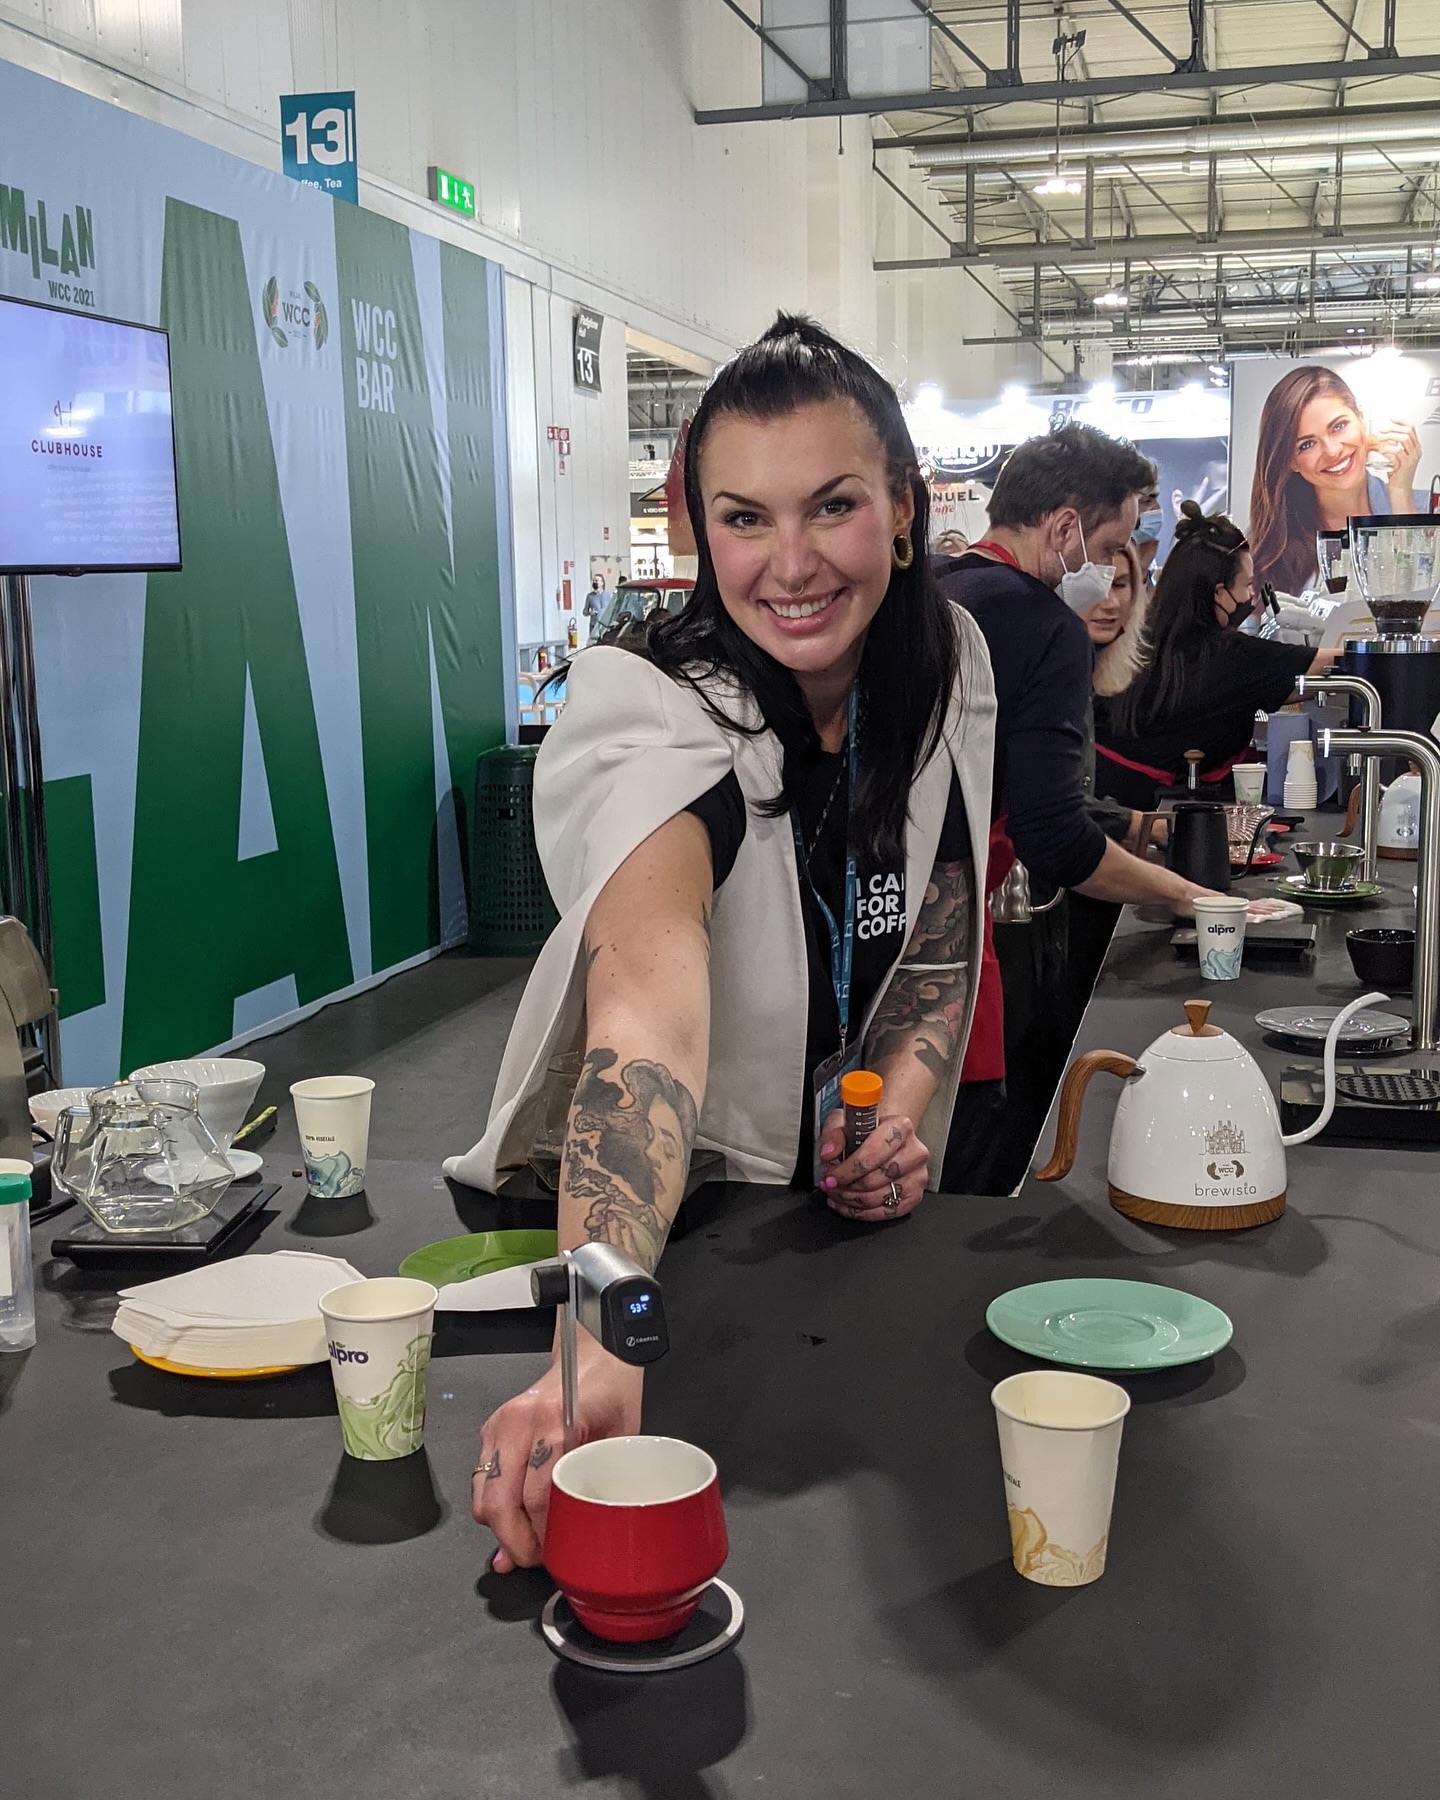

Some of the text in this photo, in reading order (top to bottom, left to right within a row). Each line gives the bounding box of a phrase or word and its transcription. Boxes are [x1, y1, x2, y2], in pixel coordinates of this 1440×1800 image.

[324, 178, 342, 188] Tea
[0, 184, 95, 279] MILAN
[48, 280, 95, 307] WCC 2021
[282, 302, 310, 327] WCC
[351, 298, 397, 360] WCC
[577, 349, 594, 384] 13
[356, 356, 396, 415] BAR
[31, 439, 103, 458] CLUBHOUSE
[855, 877, 862, 897] I
[856, 894, 899, 919] FOR
[1207, 924, 1236, 936] alpro
[1194, 1182, 1257, 1197] brewista
